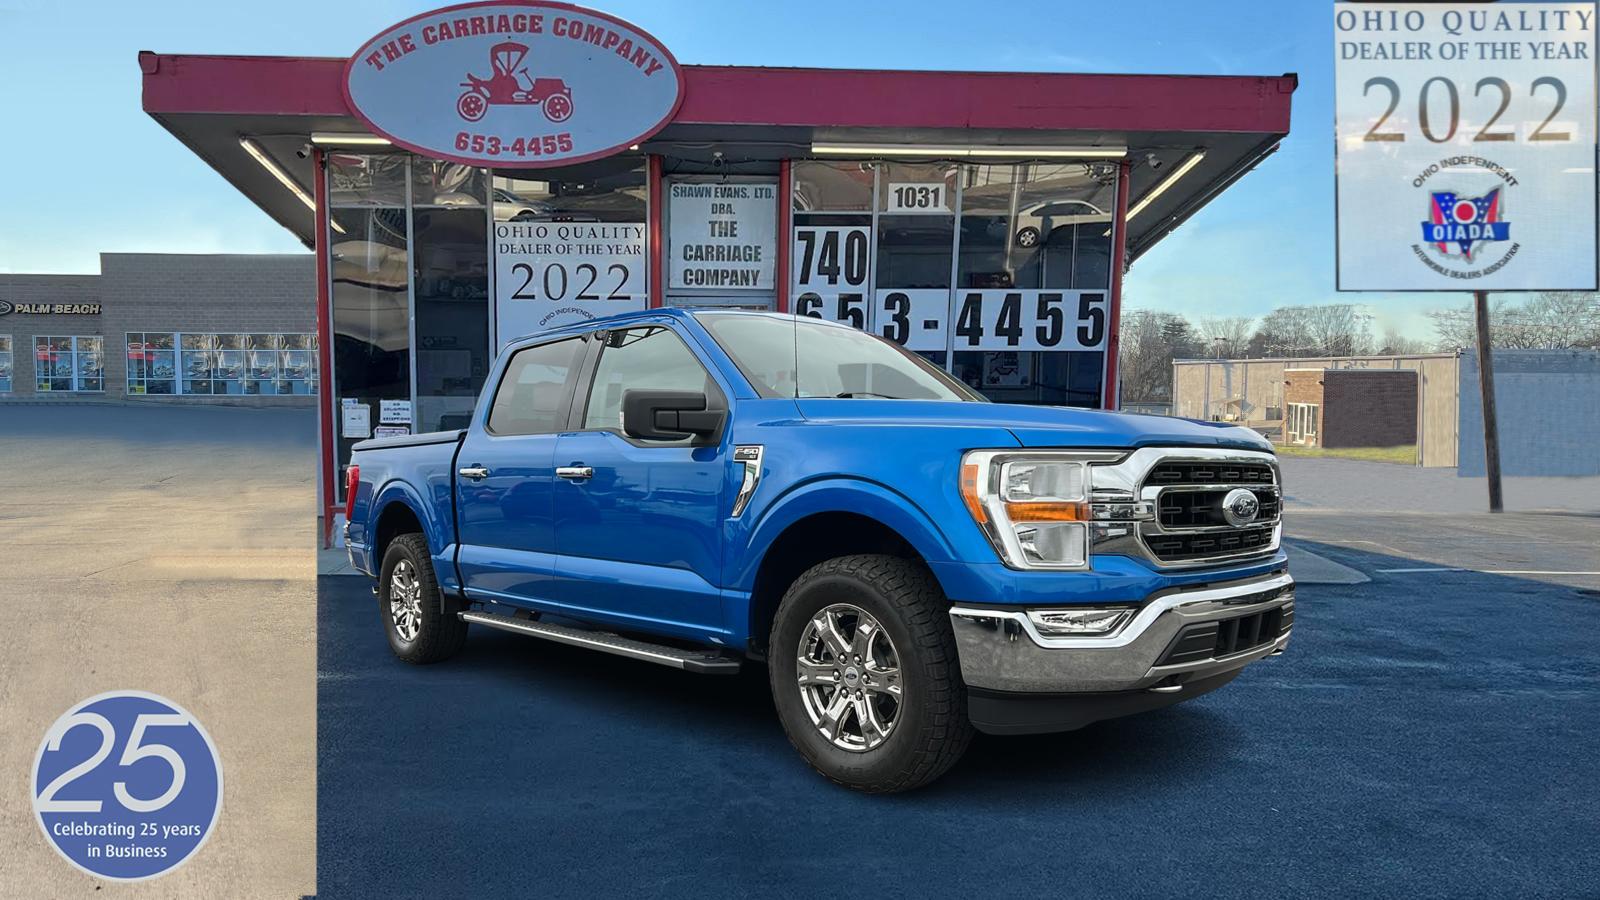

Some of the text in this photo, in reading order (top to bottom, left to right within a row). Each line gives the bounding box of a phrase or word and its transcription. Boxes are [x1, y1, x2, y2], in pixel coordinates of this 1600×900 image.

[1336, 10, 1592, 36] OHIO QUALITY
[366, 14, 664, 77] THE CARRIAGE COMPANY
[1340, 42, 1589, 60] DEALER OF THE YEAR
[1363, 76, 1570, 143] 2022
[455, 132, 573, 156] 653-4455
[1413, 156, 1519, 188] OHIO INDEPENDENT
[673, 186, 712, 198] SHAWN
[754, 187, 775, 199] LTD.
[894, 186, 940, 208] 1031
[711, 203, 736, 215] DBA.
[497, 226, 644, 241] OHIO QUALITY
[709, 221, 738, 237] THE
[1433, 225, 1495, 240] OIADA
[500, 244, 641, 255] DEALER OF THE YEAR
[683, 244, 762, 262] CARRIAGE
[797, 230, 868, 286] 740
[1411, 242, 1520, 280] AUTOMOBILE DEALERS ASSOCIATION
[511, 263, 632, 301] 2022
[683, 268, 761, 286] COMPANY
[15, 304, 100, 314] PALM BEACH
[539, 312, 555, 326] OHIO
